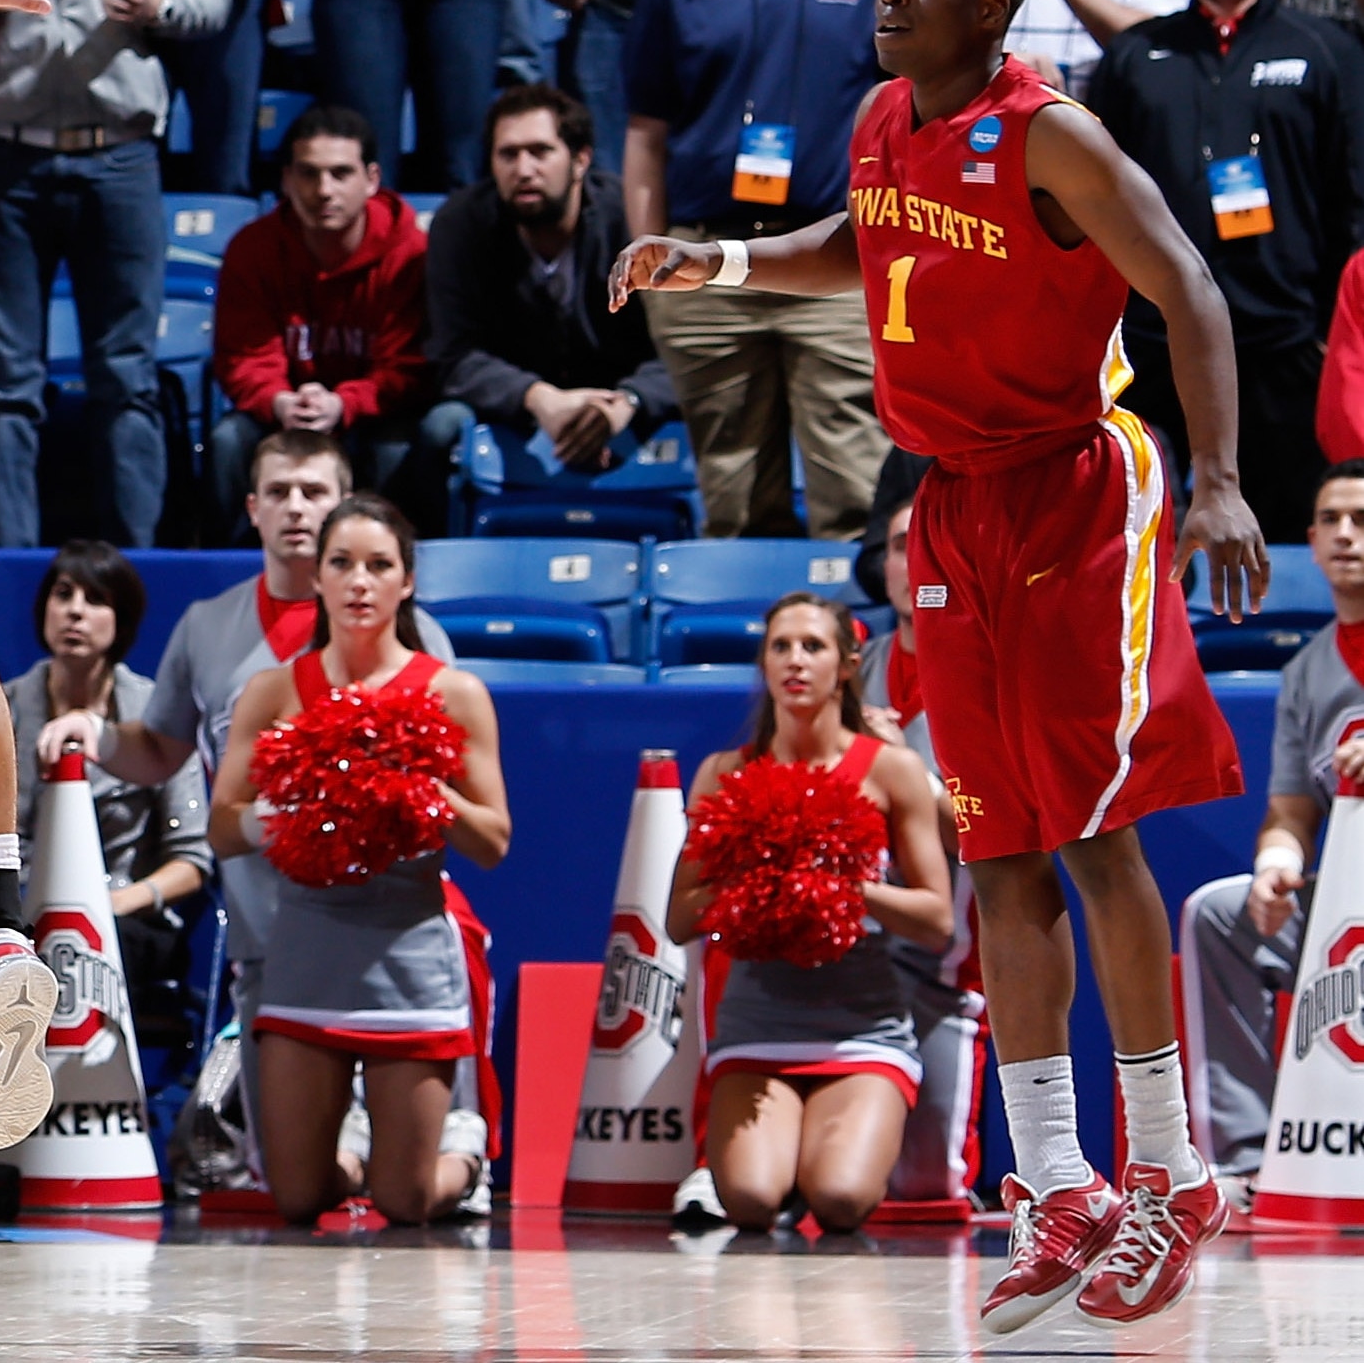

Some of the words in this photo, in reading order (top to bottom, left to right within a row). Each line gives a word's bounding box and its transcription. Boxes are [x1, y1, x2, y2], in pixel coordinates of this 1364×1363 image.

[851, 188, 901, 227] WA
[905, 195, 1008, 259] STATE
[882, 255, 916, 343] 1
[35, 1101, 147, 1136] KEYES
